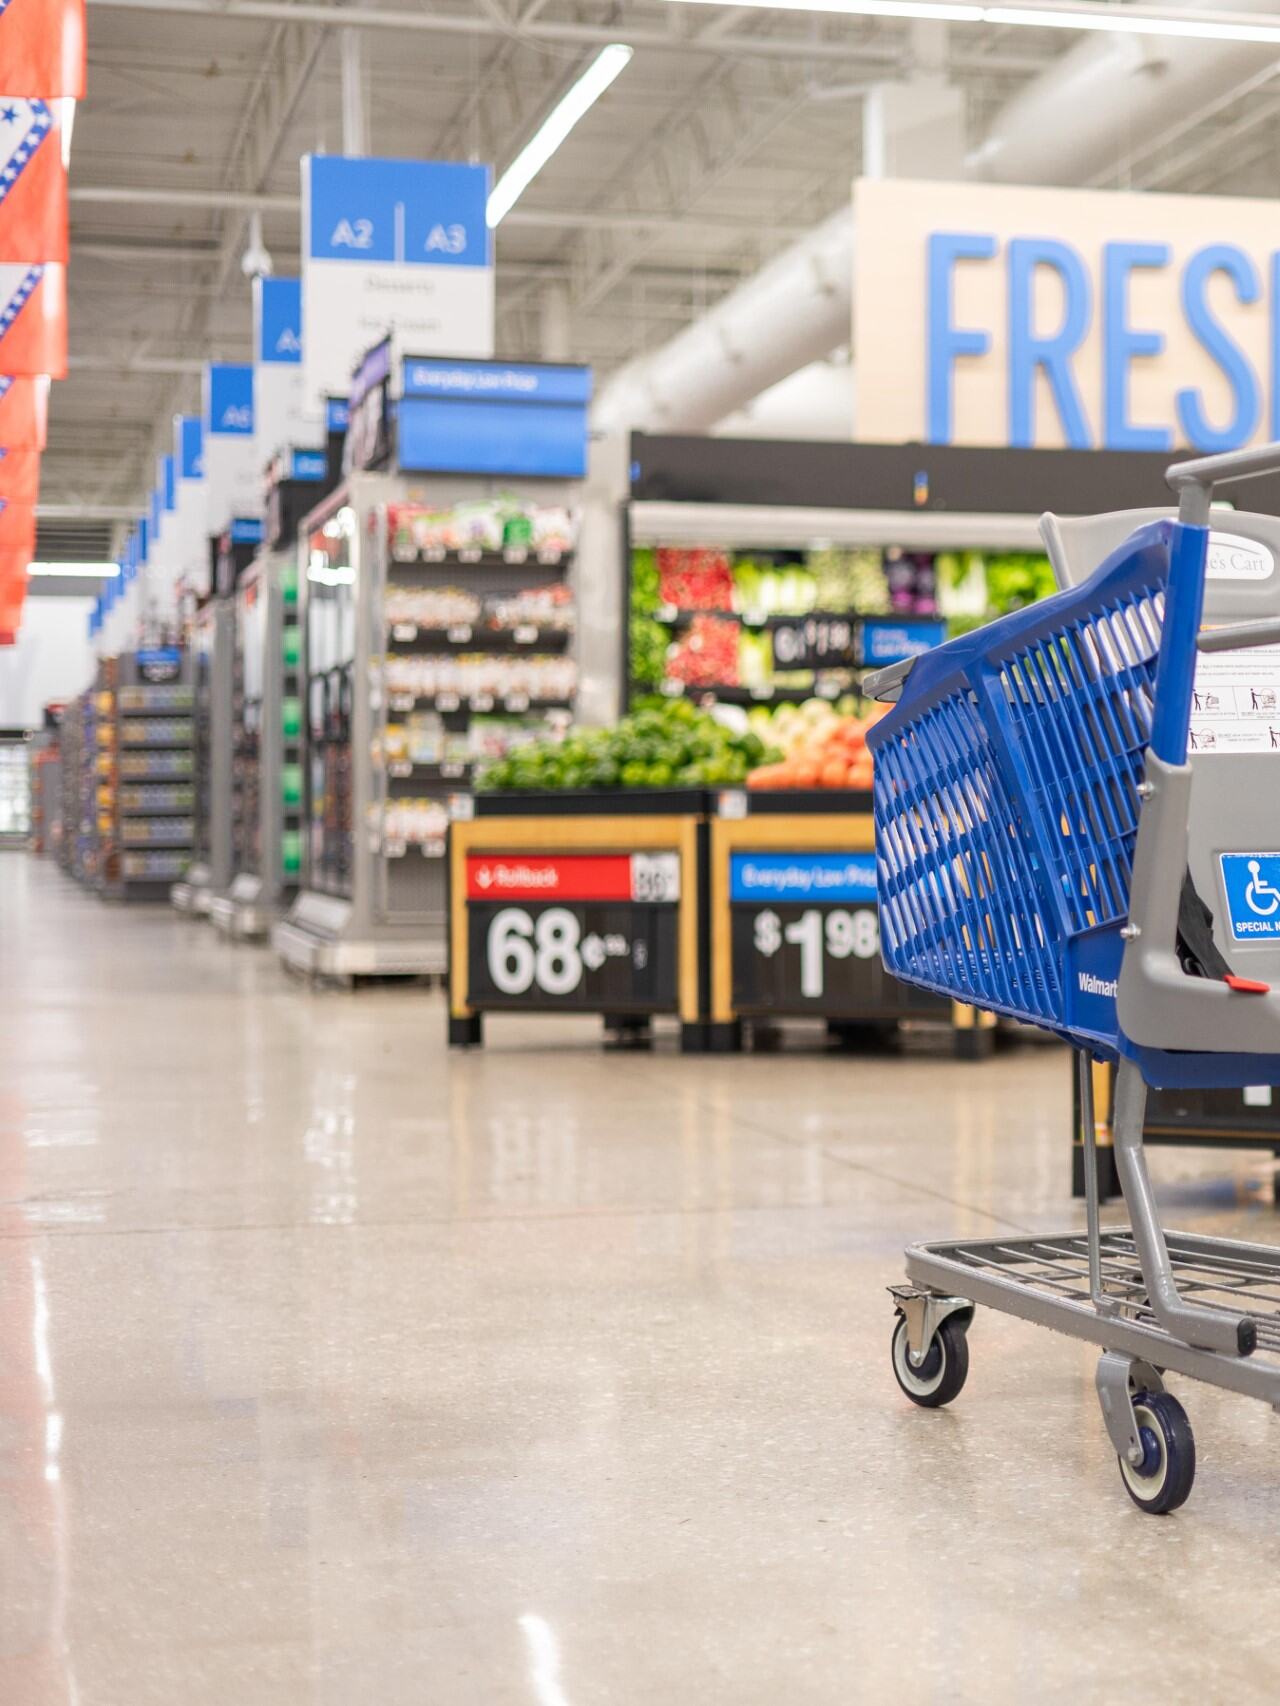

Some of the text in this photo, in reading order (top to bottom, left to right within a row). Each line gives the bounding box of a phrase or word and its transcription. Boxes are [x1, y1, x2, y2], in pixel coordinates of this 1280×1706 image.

[330, 218, 374, 250] A2
[424, 223, 468, 254] A3
[1230, 552, 1264, 572] Cart
[742, 863, 812, 892] Everyday
[1235, 920, 1274, 933] SPECIAL
[1078, 971, 1118, 998] Walmart
